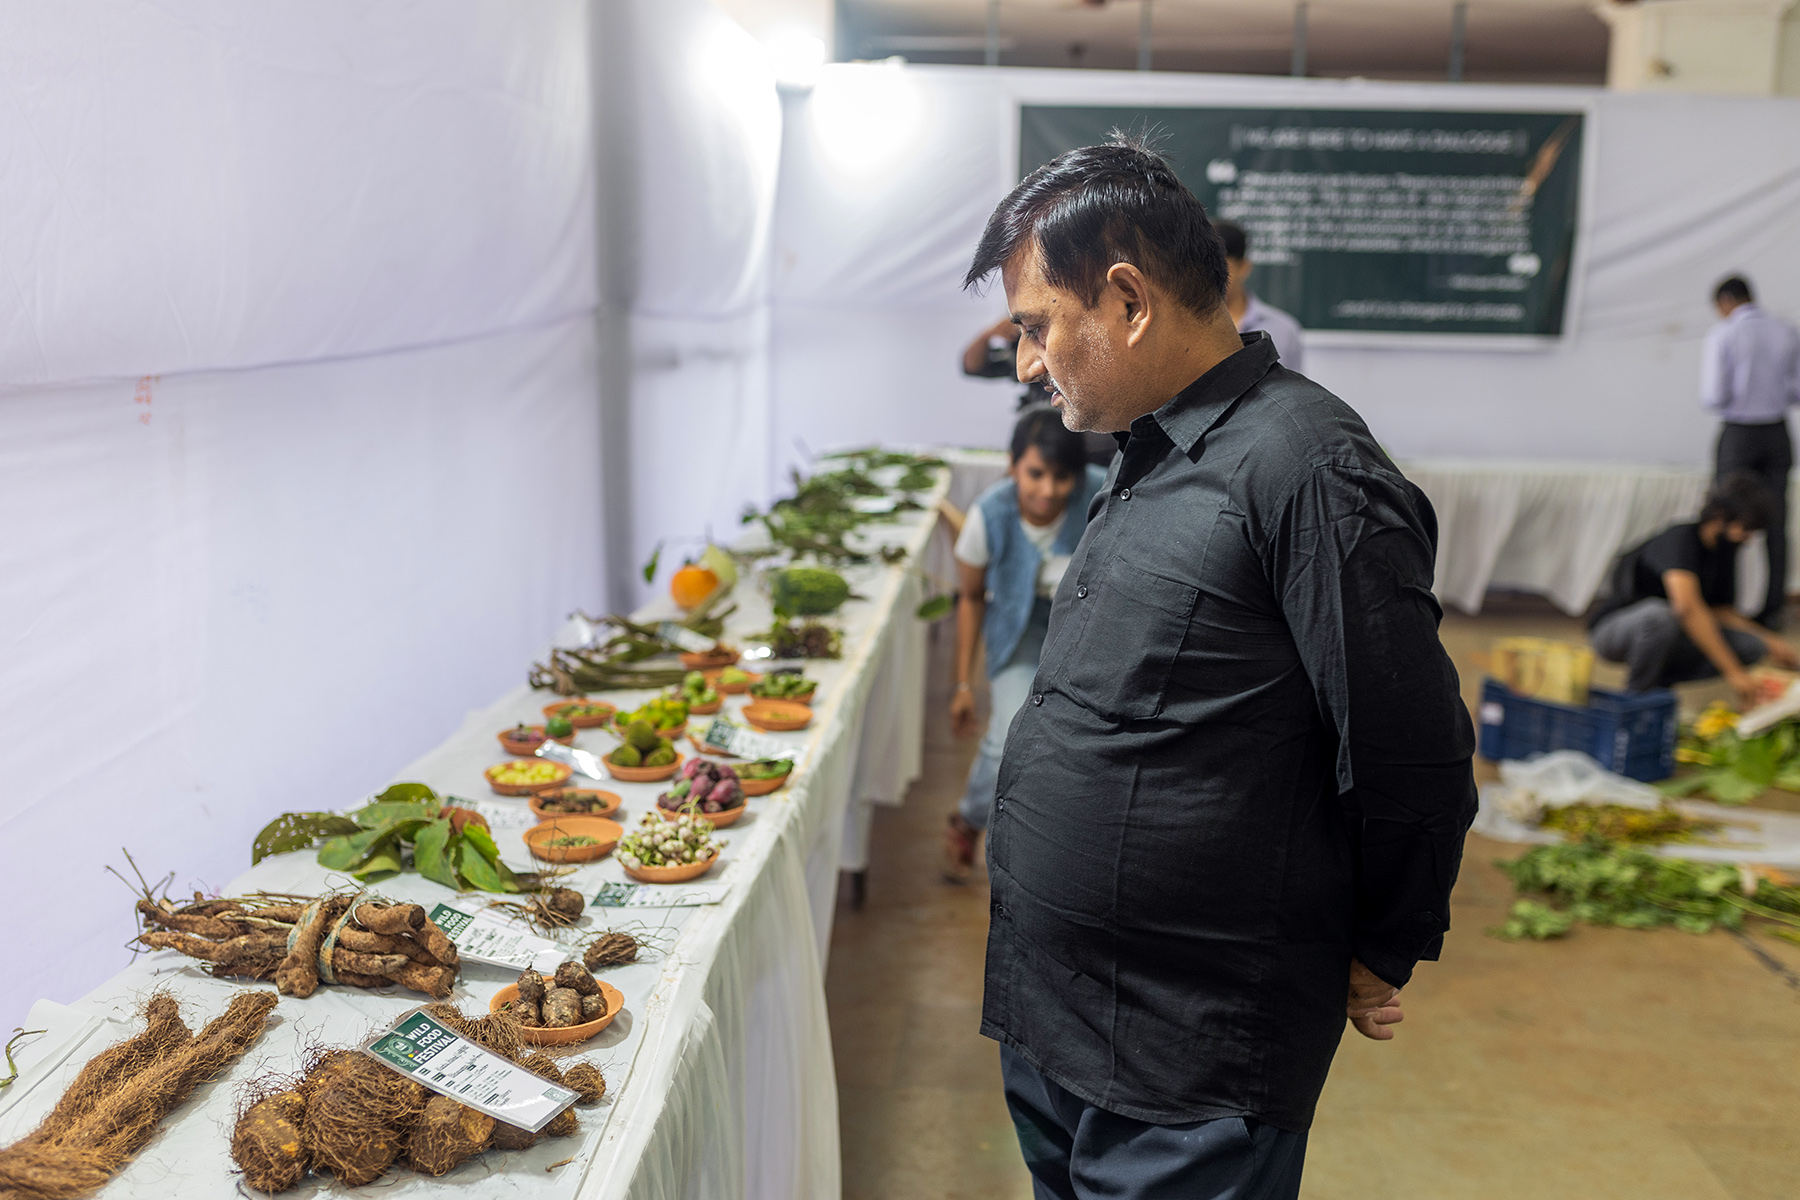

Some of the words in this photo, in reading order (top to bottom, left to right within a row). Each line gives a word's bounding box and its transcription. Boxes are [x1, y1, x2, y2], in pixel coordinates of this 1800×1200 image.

[434, 909, 452, 926] WILD
[405, 1022, 431, 1041] WILD
[416, 1028, 443, 1048] FOOD
[412, 1034, 457, 1064] FESTIVAL
